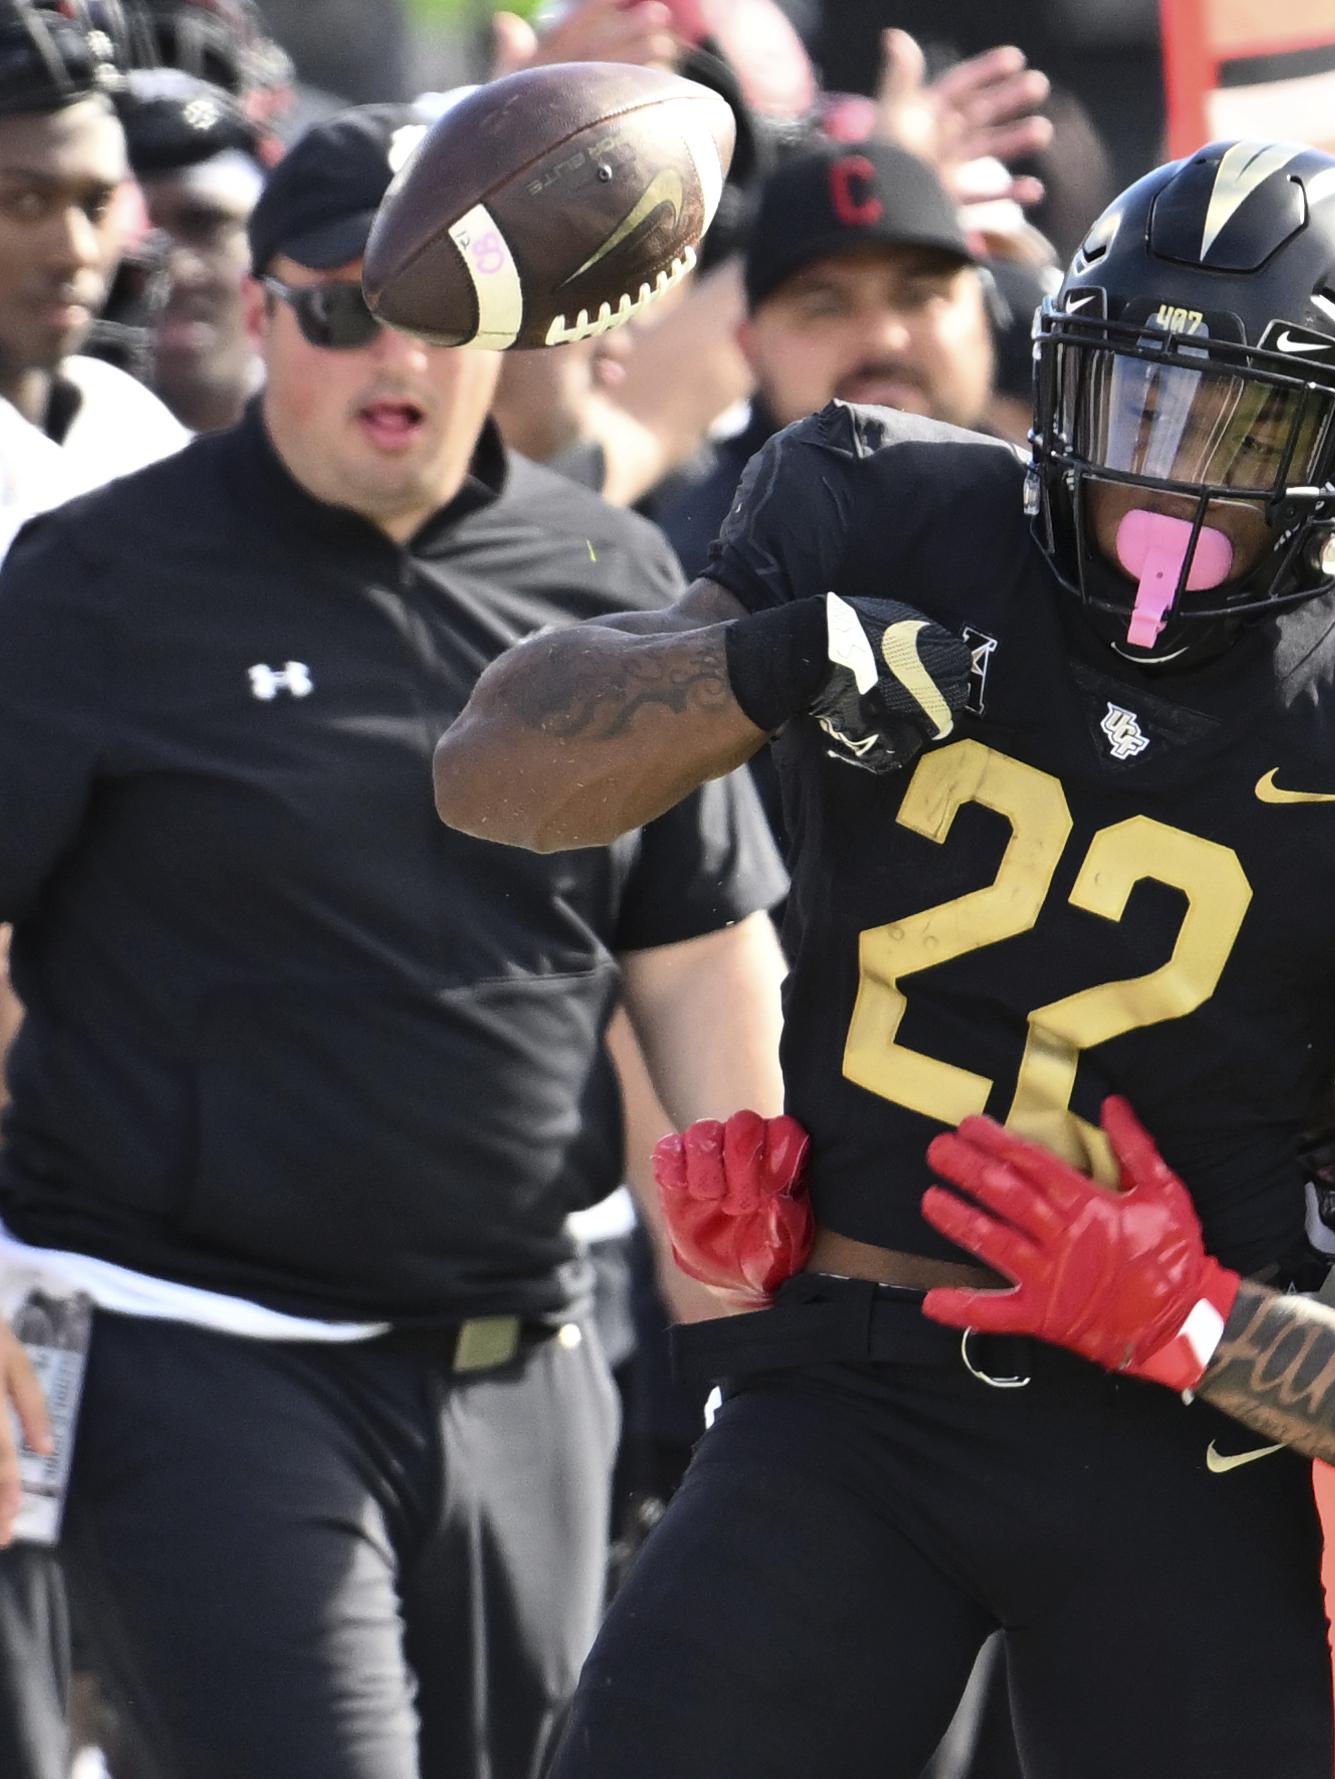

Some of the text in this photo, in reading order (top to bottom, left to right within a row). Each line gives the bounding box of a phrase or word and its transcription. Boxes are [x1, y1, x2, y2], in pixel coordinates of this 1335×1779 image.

[831, 155, 884, 225] C
[1100, 701, 1150, 760] UCF
[843, 738, 1253, 1191] 22
